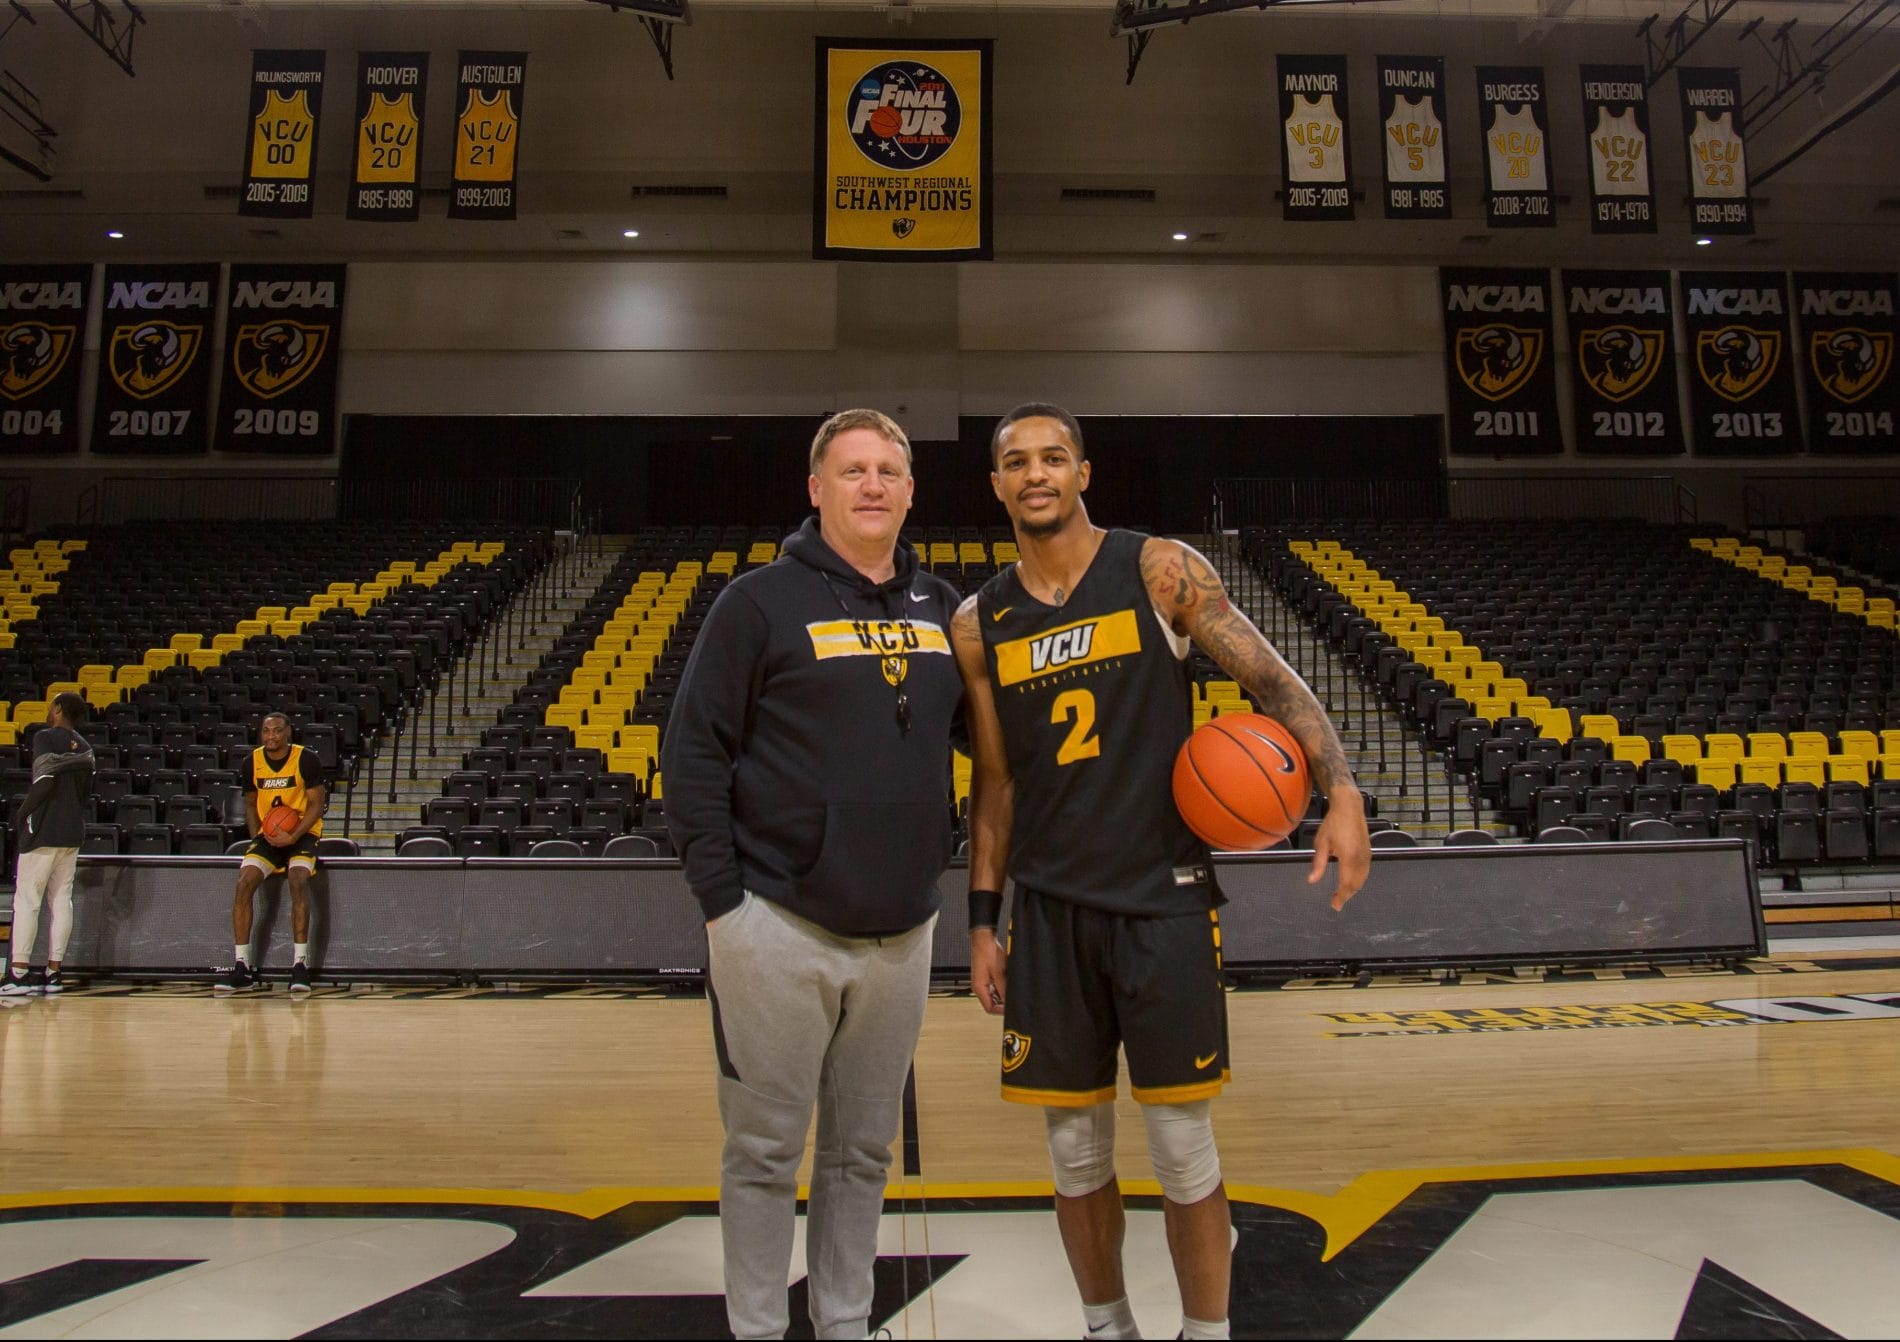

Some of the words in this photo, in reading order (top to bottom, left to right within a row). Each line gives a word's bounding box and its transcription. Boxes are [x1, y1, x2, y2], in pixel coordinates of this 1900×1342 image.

[255, 71, 321, 84] HOLLINGSWORTH
[367, 67, 418, 85] HOOVER
[461, 65, 522, 84] AUSTGULEN
[1285, 74, 1338, 91] MAYNOR
[1384, 69, 1435, 88] DUNCAN
[880, 84, 946, 109] FINAL
[1484, 83, 1540, 102] BURGESS
[1584, 82, 1644, 100] HENDERSON
[1686, 88, 1735, 106] WARREN
[259, 119, 309, 142] VCU
[364, 122, 414, 147] VCU
[463, 120, 513, 143] VCU
[898, 136, 953, 144] HOUSTON
[1289, 122, 1340, 147] VCU
[1388, 122, 1440, 147] VCU
[266, 144, 295, 165] 00
[469, 144, 495, 166] 21
[1492, 132, 1541, 157] VCU
[1594, 136, 1644, 160] VCU
[1693, 139, 1740, 163] VCU
[371, 147, 401, 169] 20
[1308, 146, 1324, 169] 3
[1407, 147, 1424, 171] 5
[1507, 157, 1530, 179] 20
[836, 176, 910, 188] SOUTHWEST
[914, 177, 971, 188] REGIONAL
[1605, 160, 1635, 182] 22
[1704, 164, 1734, 186] 23
[247, 183, 308, 203] 2005-2009
[358, 190, 413, 209] 1985-1989
[457, 188, 511, 207] 1999-2003
[835, 189, 972, 211] CHAMPIONS
[1289, 188, 1349, 207] 2005-2009
[1391, 189, 1444, 208] 1981-1985
[1493, 196, 1549, 215] 2008-2012
[1598, 202, 1649, 221] 1974-1978
[1696, 204, 1747, 223] 1990-1994
[107, 281, 209, 309] NCAA
[232, 281, 335, 308] NCAA
[1448, 285, 1544, 312] NCAA
[1570, 287, 1665, 314] NCAA
[1688, 288, 1783, 315] NCAA
[1800, 288, 1895, 316] NCAA
[1, 410, 63, 436] 004
[109, 410, 192, 436] 2007
[233, 409, 320, 435] 2009
[1473, 411, 1539, 436] 2011
[1593, 412, 1665, 437] 2012
[1712, 413, 1783, 438] 2013
[1826, 411, 1894, 437] 2014
[852, 622, 919, 650] VCU
[1029, 622, 1097, 672] VCU
[1051, 688, 1100, 766] 2
[263, 777, 289, 788] RAMS
